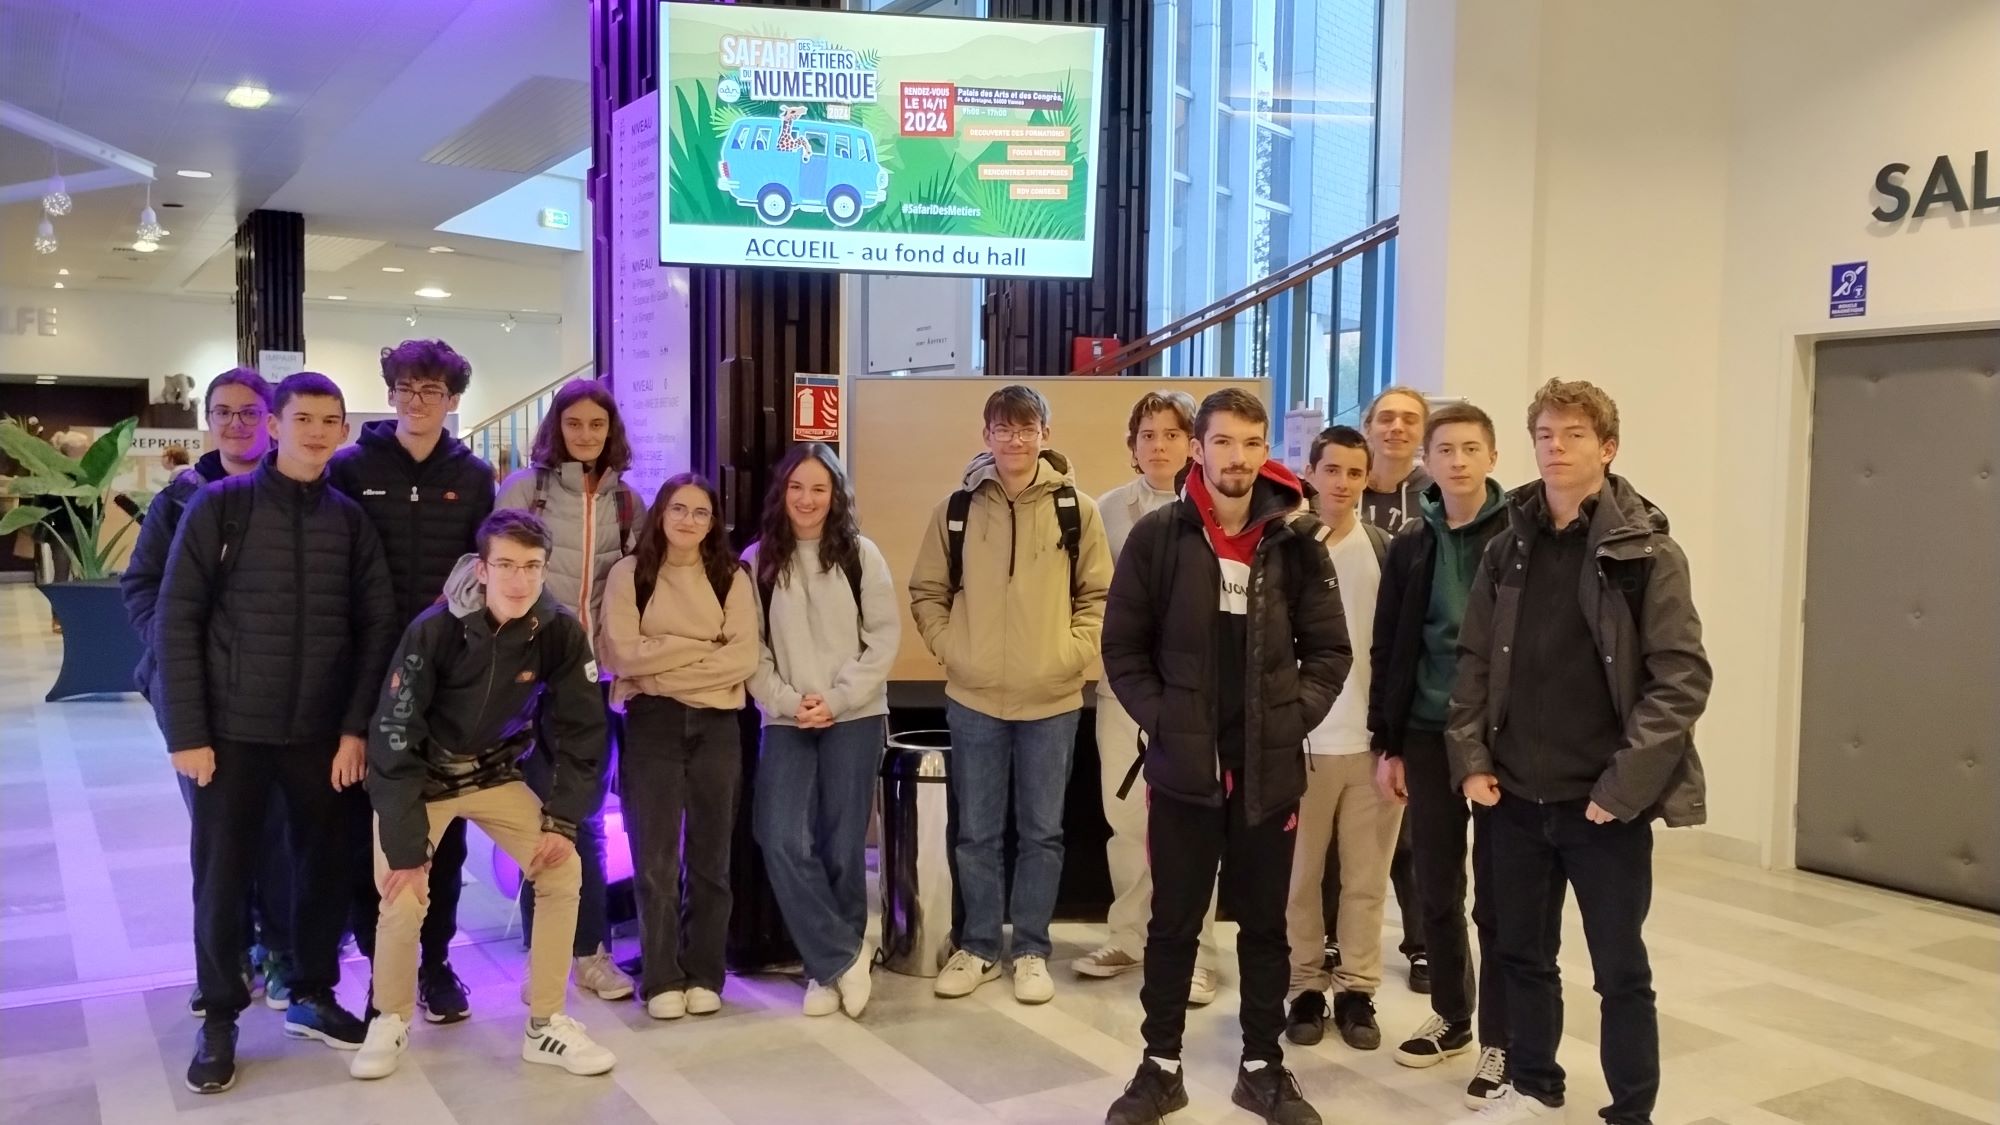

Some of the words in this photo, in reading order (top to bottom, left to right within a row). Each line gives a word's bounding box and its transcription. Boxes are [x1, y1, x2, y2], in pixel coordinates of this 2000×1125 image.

[722, 36, 795, 69] SAFARI
[798, 42, 811, 51] DES
[798, 49, 853, 69] MÉTIERS
[742, 69, 751, 78] DU
[754, 70, 875, 99] NUMÉRIQUE
[904, 87, 950, 96] RENDEZ-VOUS
[957, 88, 979, 97] Palais
[904, 98, 920, 109] LE
[922, 99, 947, 110] 14/11
[631, 116, 652, 136] NIVEAU
[904, 112, 948, 132] 2024
[1011, 129, 1024, 137] DES
[1025, 129, 1065, 137] FORMATIONS
[983, 168, 1025, 176] RENCONTRES
[901, 203, 981, 216] #SafariDesMetiers
[745, 238, 840, 260] ACCUEIL
[862, 246, 888, 262] au
[895, 243, 944, 264] fond
[953, 245, 979, 265] du
[987, 246, 1026, 267] hall
[632, 257, 654, 272] NIVEAU
